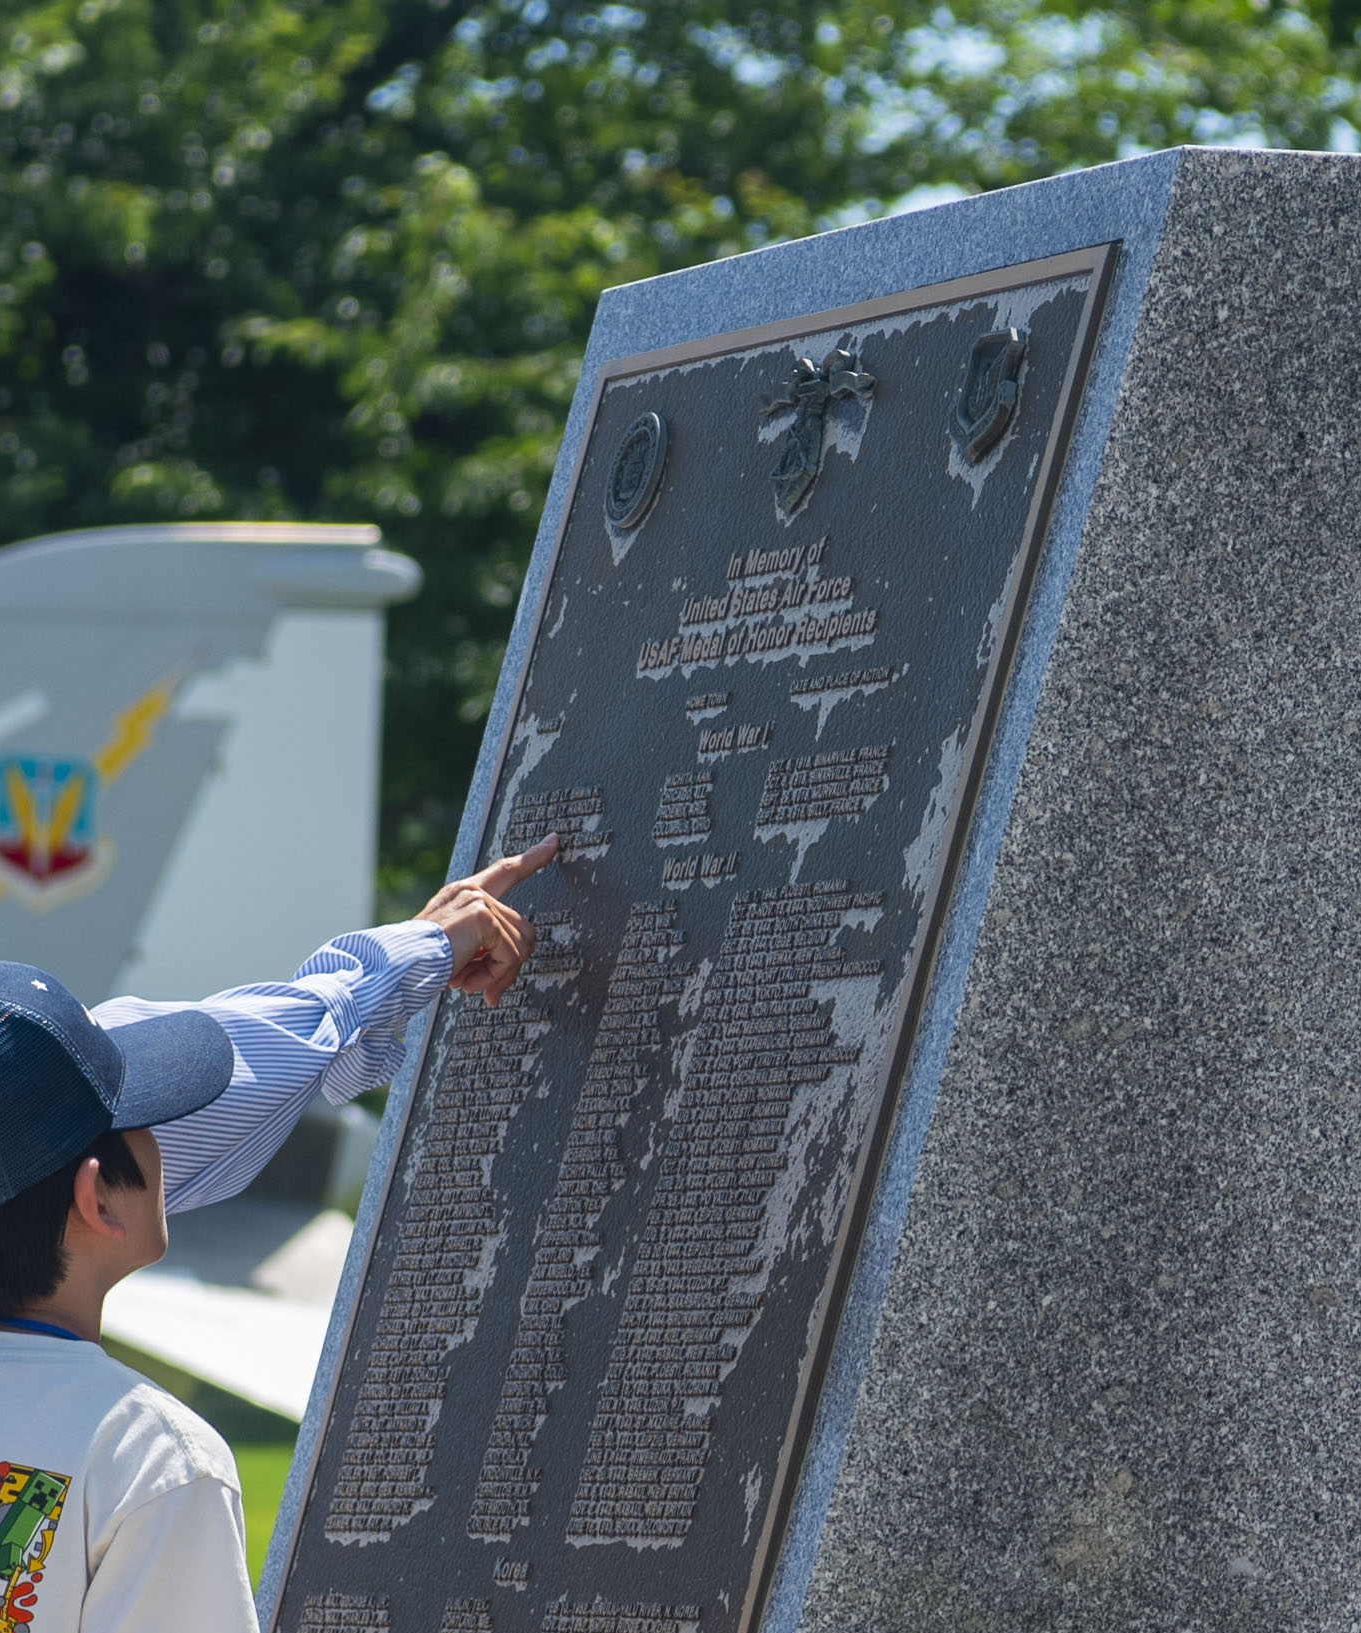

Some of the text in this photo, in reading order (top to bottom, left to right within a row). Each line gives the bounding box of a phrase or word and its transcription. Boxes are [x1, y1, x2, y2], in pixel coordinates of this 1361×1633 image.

[724, 534, 827, 582] In Memory of
[678, 569, 854, 624] United States Air Force
[635, 602, 879, 670] USAF Medal of Honor Recipients
[695, 720, 770, 752] World War I
[659, 851, 737, 881] World War II
[492, 1556, 530, 1579] Korea
